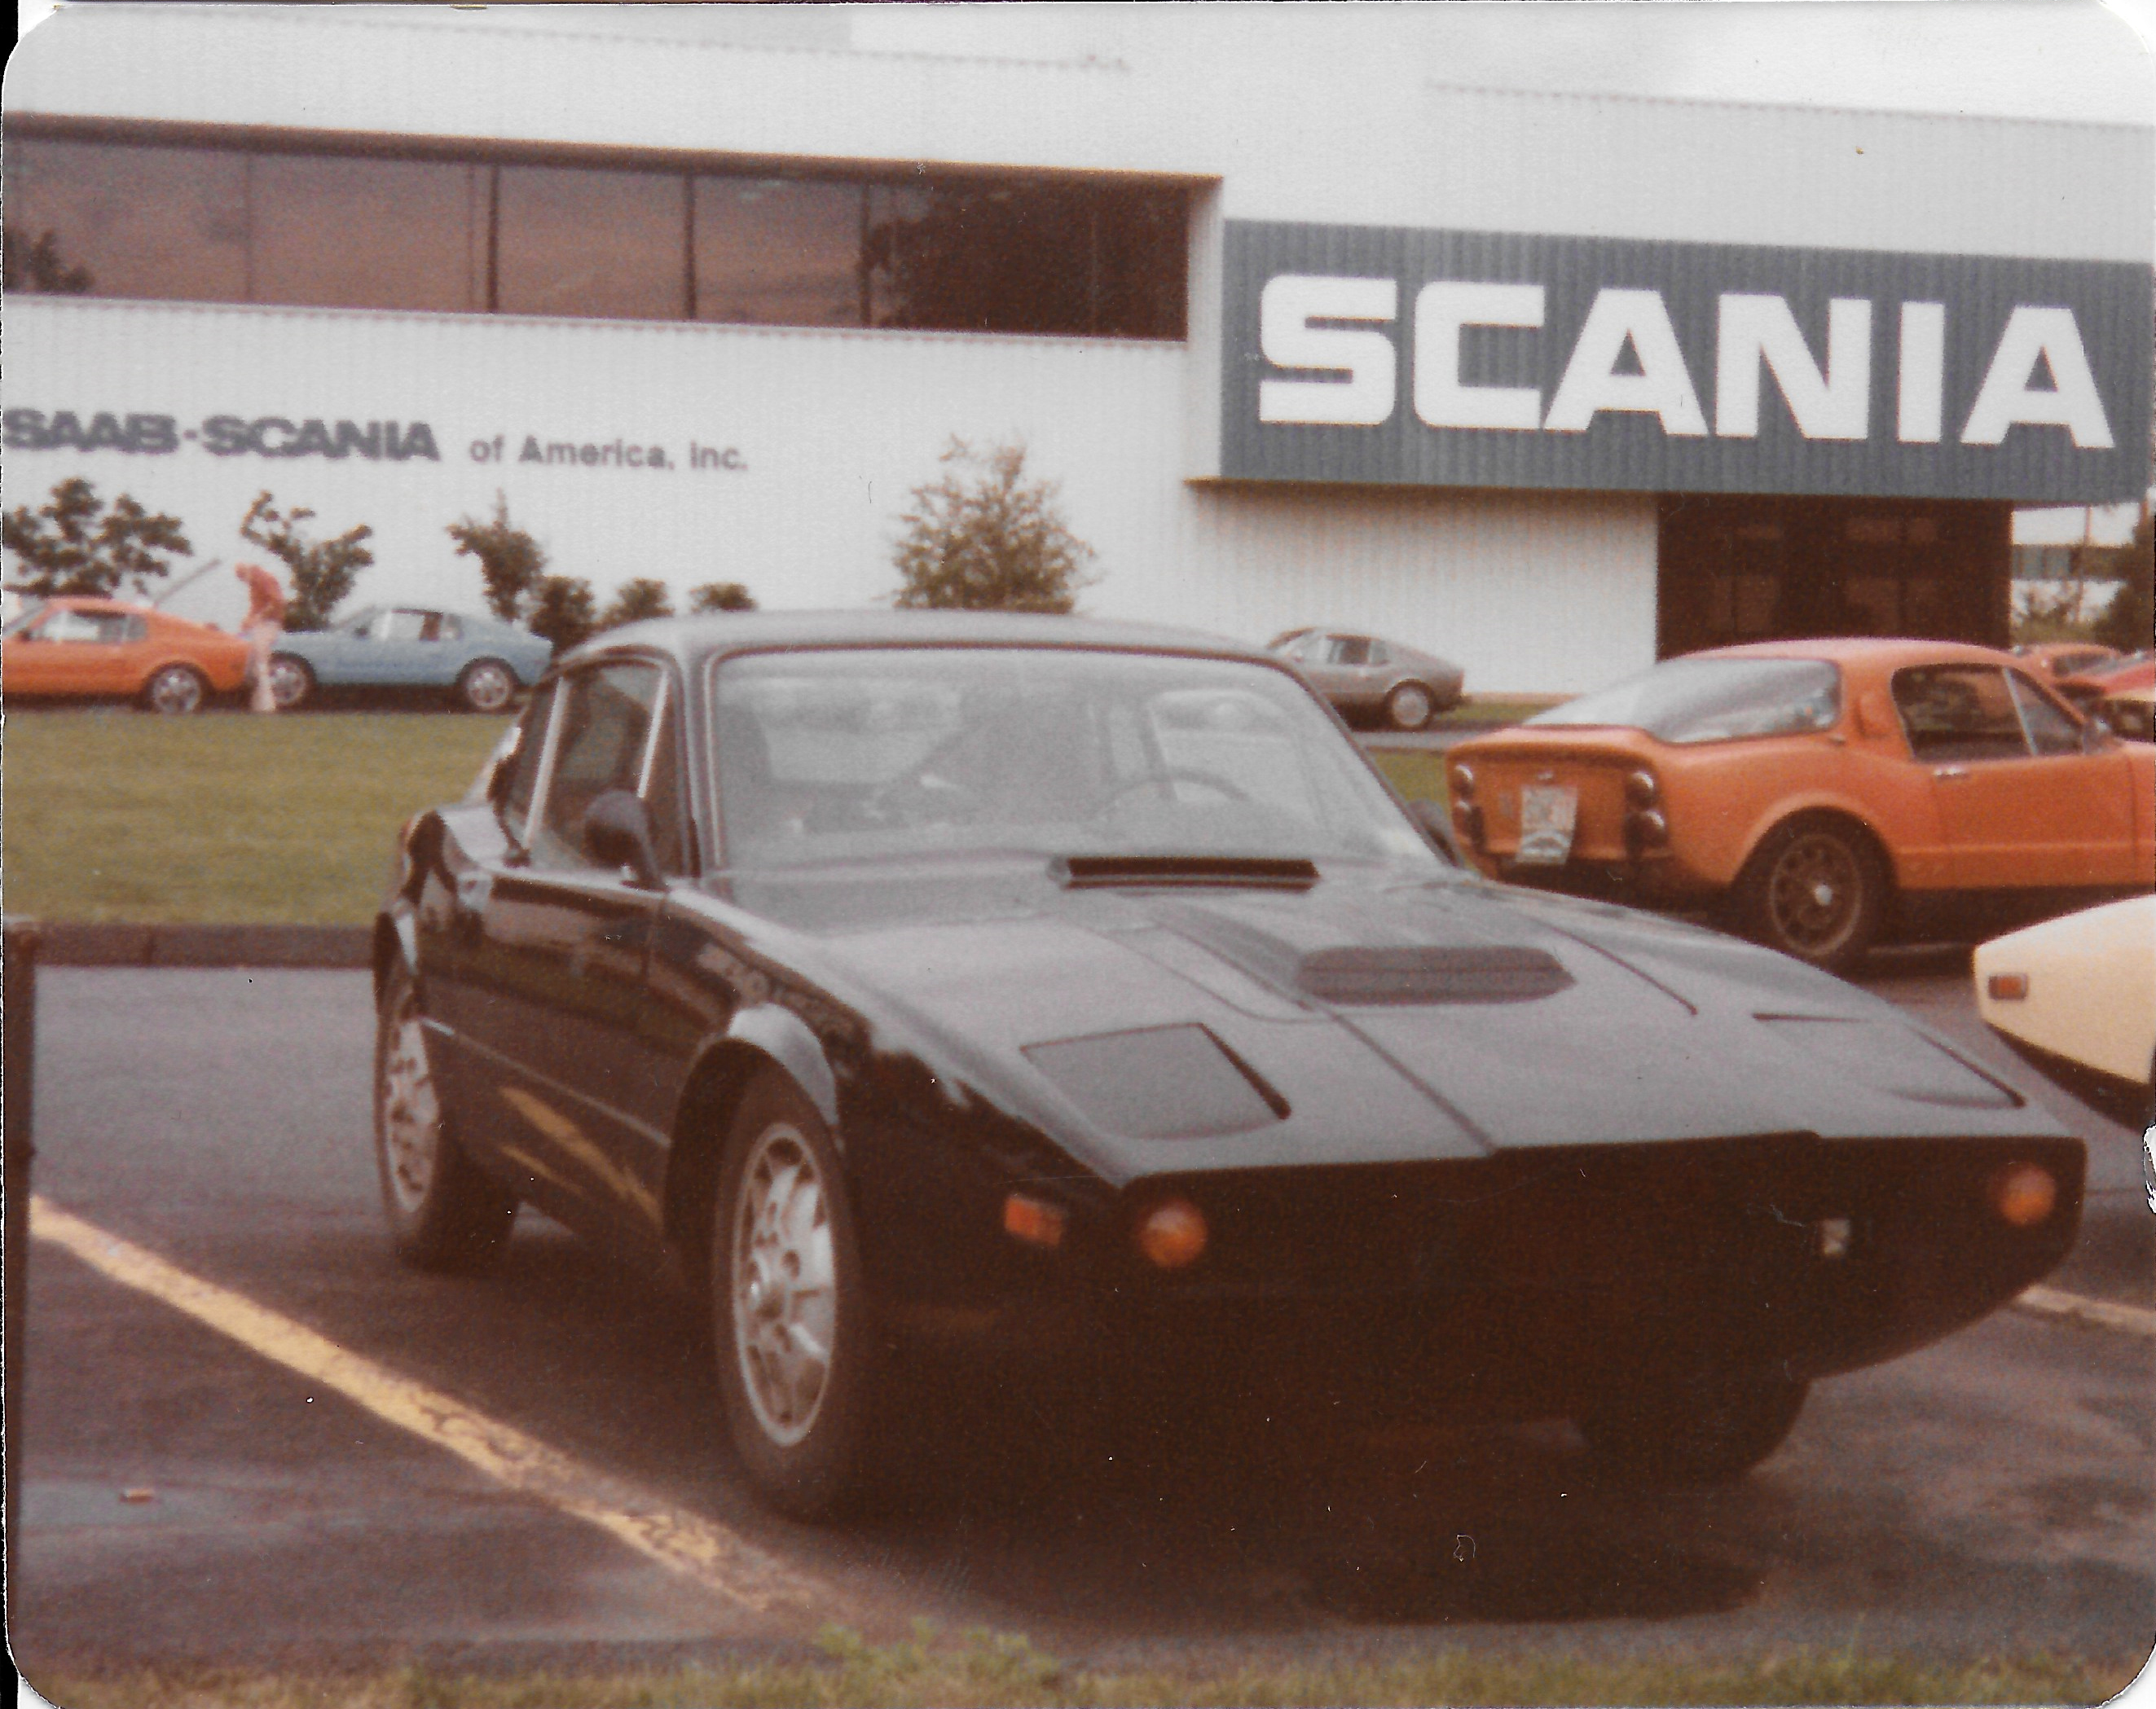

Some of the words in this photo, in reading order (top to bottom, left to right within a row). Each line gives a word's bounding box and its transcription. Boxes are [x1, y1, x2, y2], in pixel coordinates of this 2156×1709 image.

[1259, 275, 2114, 448] SCANIA
[470, 434, 504, 463] of
[691, 441, 748, 470] Inc.
